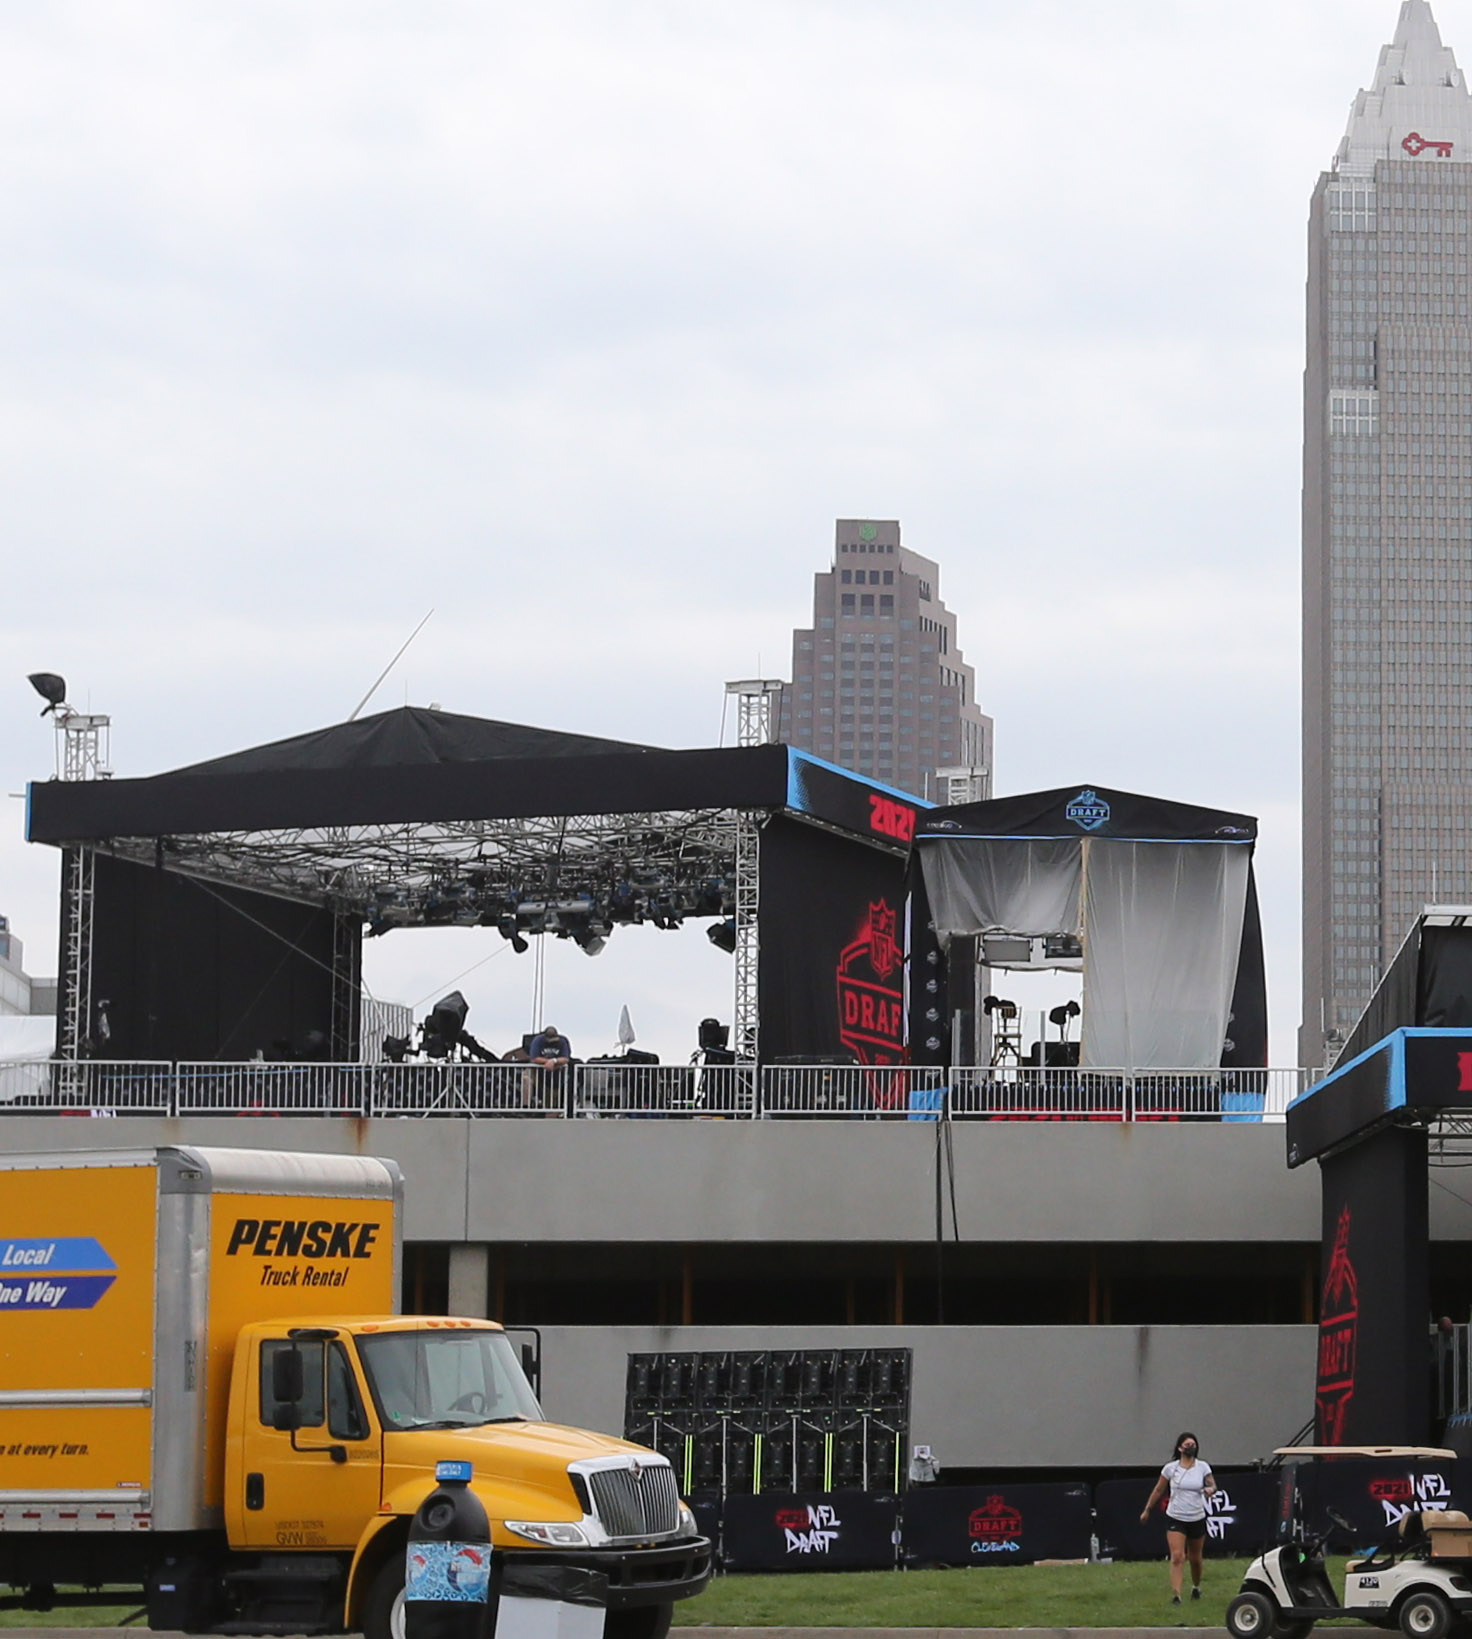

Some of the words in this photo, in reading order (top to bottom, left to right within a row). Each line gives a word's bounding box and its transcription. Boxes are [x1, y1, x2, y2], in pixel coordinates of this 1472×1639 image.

[1070, 808, 1106, 817] DRAFT
[845, 990, 901, 1037] DRAF
[226, 1219, 380, 1258] PENSKE
[2, 1243, 56, 1265] Local
[260, 1265, 300, 1286] Truck
[302, 1265, 349, 1287] Rental
[25, 1281, 67, 1308] Way
[7, 1442, 22, 1455] at
[24, 1444, 58, 1459] every
[60, 1442, 89, 1456] turn.
[806, 1504, 841, 1529] NFL
[974, 1521, 1017, 1531] DRAFT
[784, 1528, 838, 1553] DRAFT
[971, 1540, 1020, 1553] CLEVELAND
